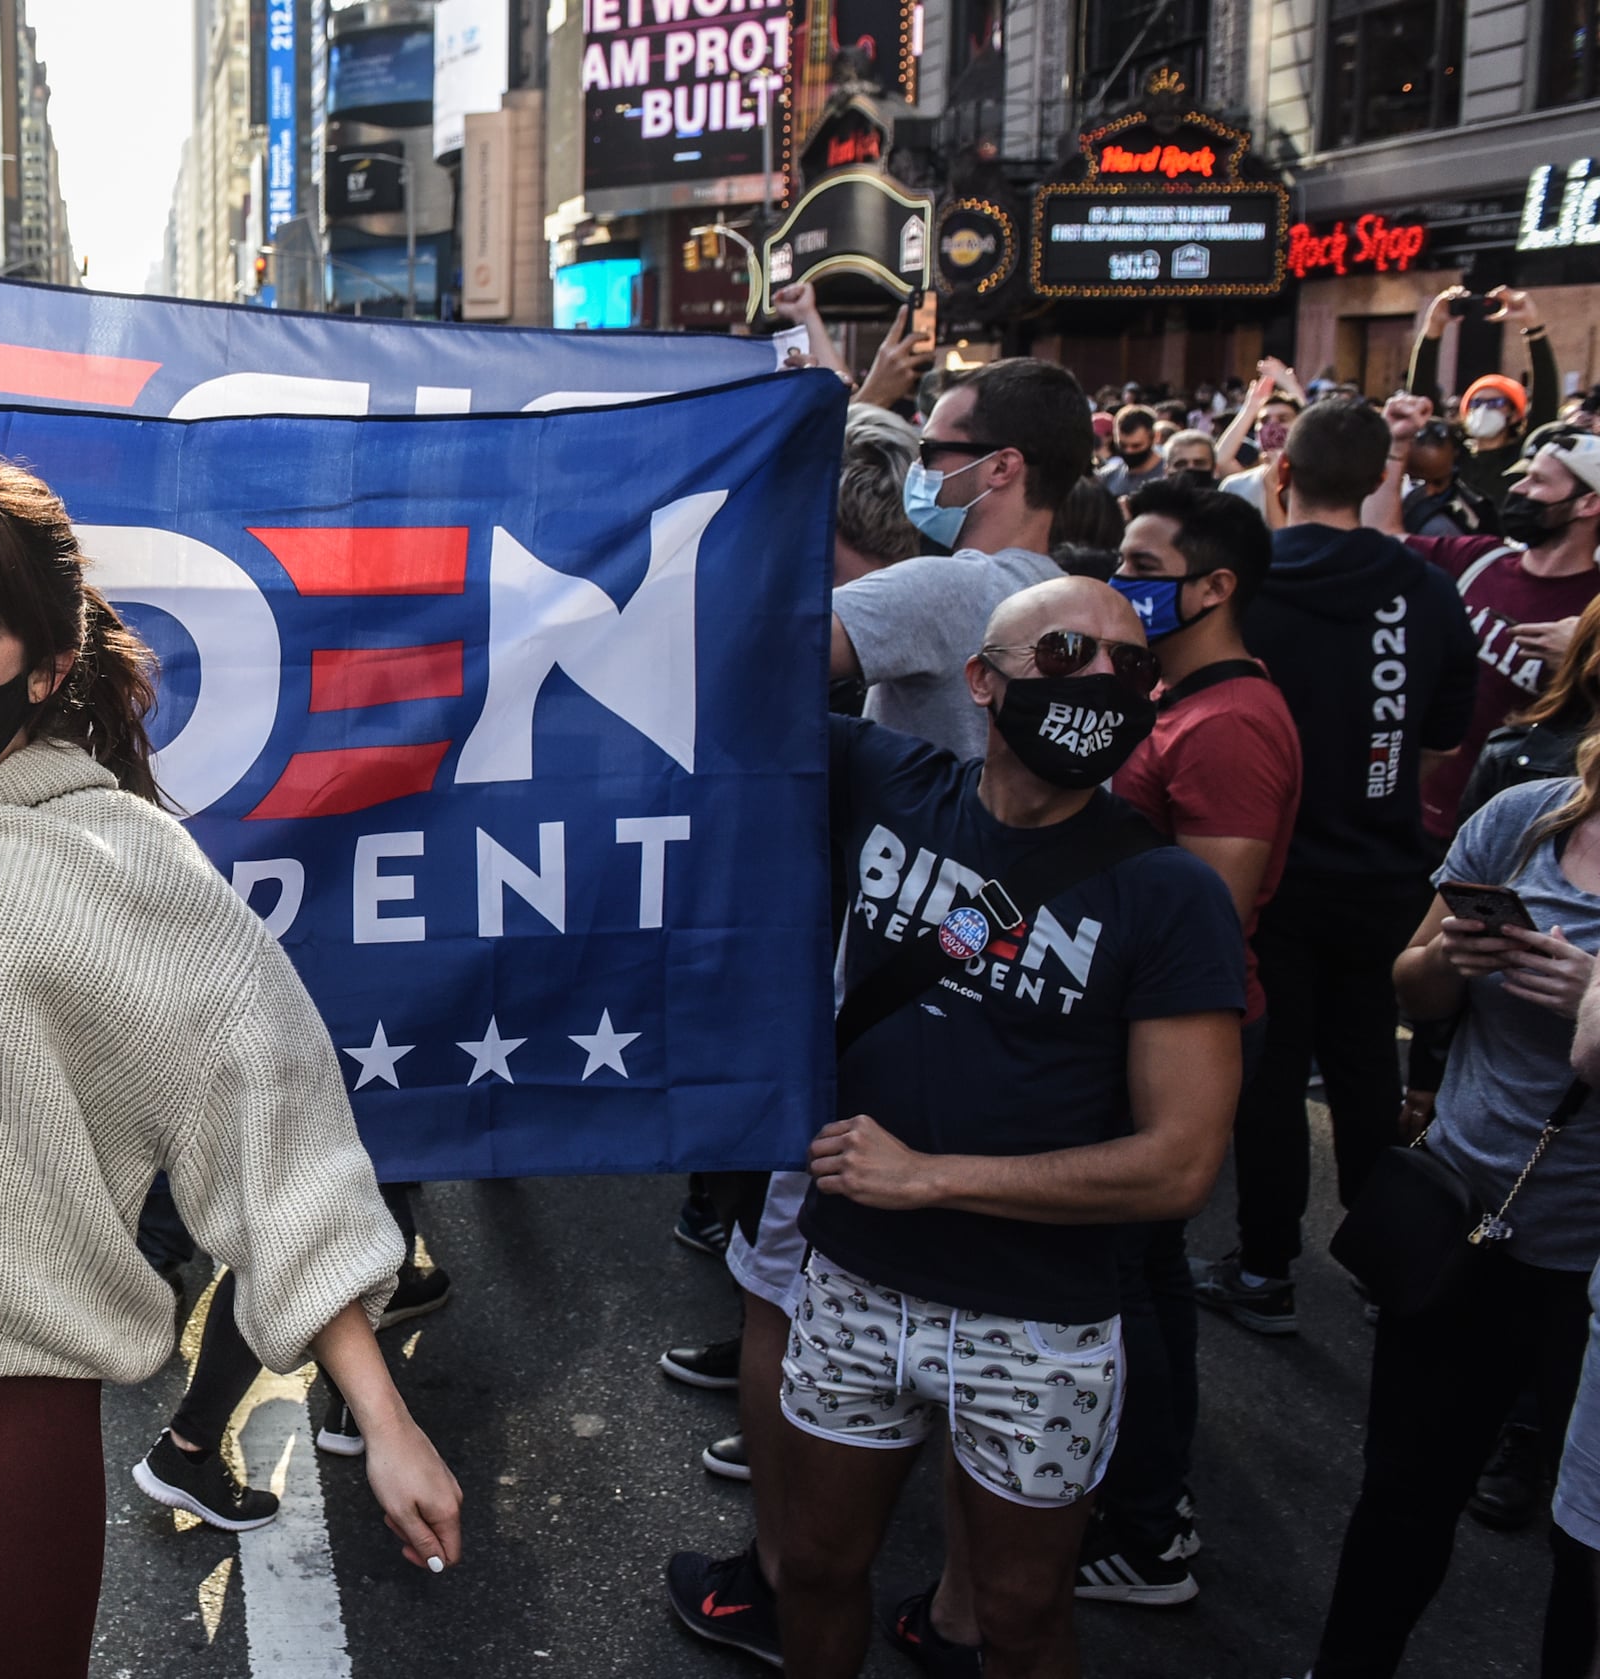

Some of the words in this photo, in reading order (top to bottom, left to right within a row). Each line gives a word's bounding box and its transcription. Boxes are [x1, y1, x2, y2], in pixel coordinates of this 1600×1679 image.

[641, 74, 783, 139] BUILT
[1101, 145, 1161, 173] Hard
[1159, 145, 1216, 178] Rock
[1288, 222, 1348, 278] Rock
[1354, 213, 1424, 272] Shop
[1038, 717, 1113, 758] HARRIS
[942, 933, 966, 956] 2020
[944, 916, 982, 952] HARRIS
[953, 911, 986, 942] BIDEN
